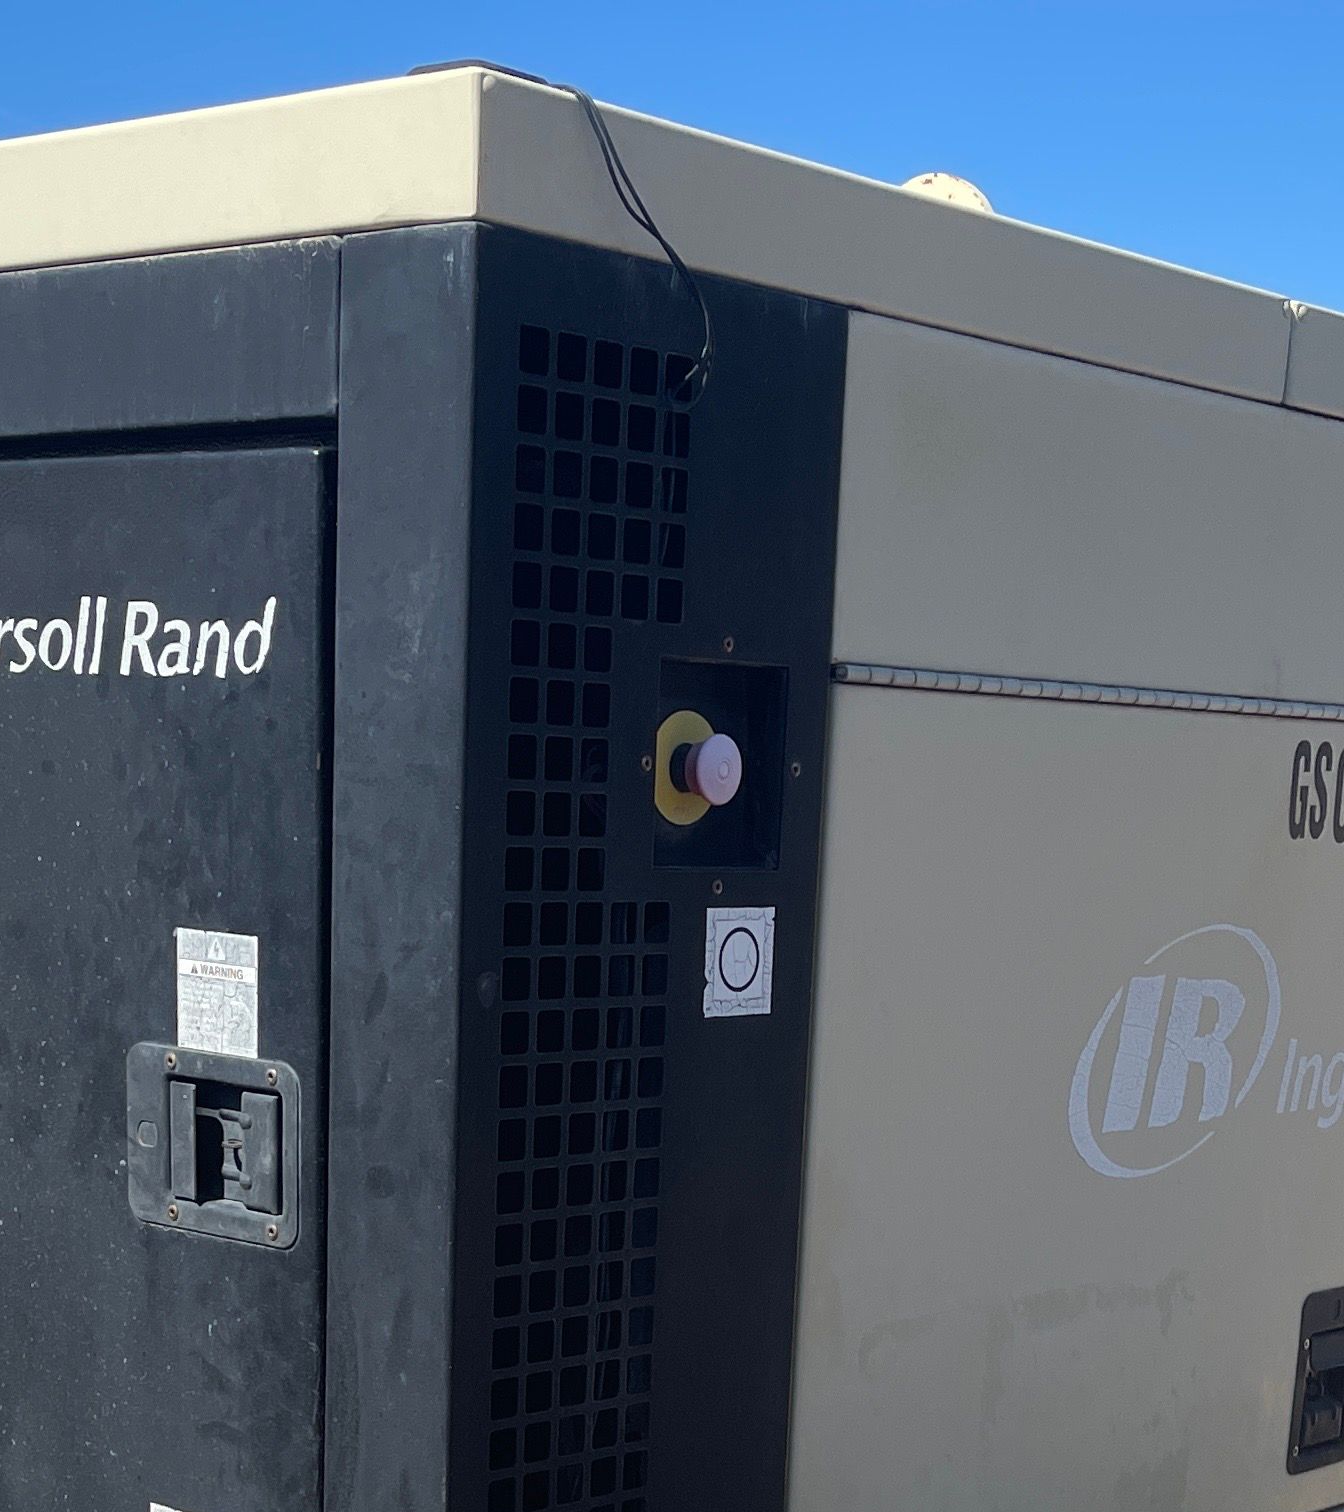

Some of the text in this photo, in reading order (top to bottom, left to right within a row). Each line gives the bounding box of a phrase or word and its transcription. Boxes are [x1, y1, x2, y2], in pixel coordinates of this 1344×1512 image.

[120, 595, 278, 681] Rand
[200, 963, 244, 979] WARNING
[1101, 973, 1246, 1134] IR
